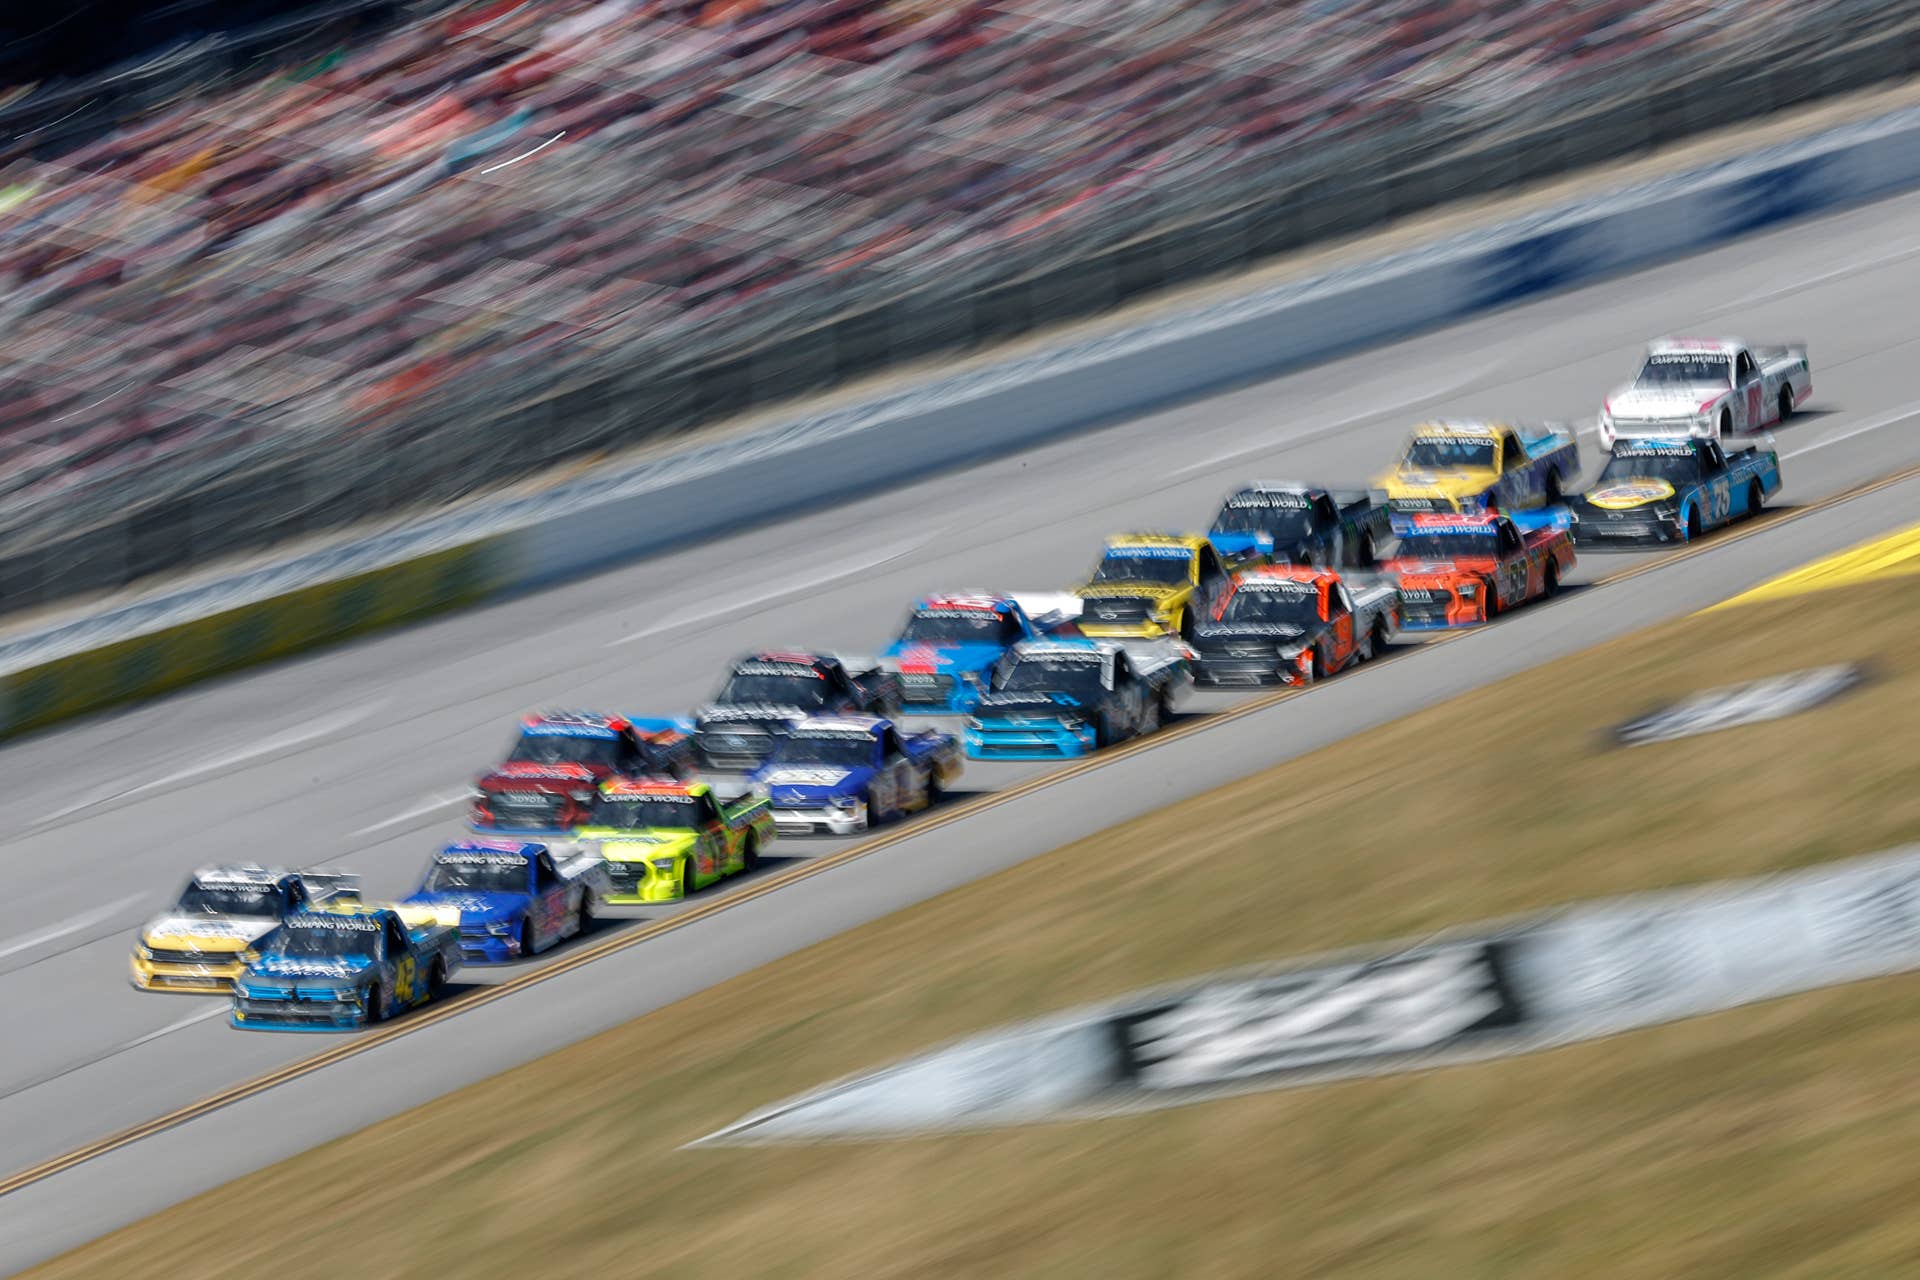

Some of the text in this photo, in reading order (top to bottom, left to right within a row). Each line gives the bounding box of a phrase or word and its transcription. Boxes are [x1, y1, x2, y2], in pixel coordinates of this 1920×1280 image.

[1650, 354, 1726, 365] CAMPING WORLD
[1416, 437, 1493, 447] CAMPING WORLD
[1616, 448, 1692, 458] CAMPING WORLD
[1229, 500, 1308, 509] CAMPING WORLD
[1397, 499, 1433, 509] TOYOTA
[1411, 525, 1492, 536] CAMPING WORLD
[1109, 549, 1193, 558] CAMPING WORLD
[1238, 584, 1320, 594] CAMPING WORLD
[603, 794, 697, 804] CAMPING WORLD
[437, 855, 529, 866] CAMPING WORLD
[287, 919, 377, 932] CAMPING WORLD
